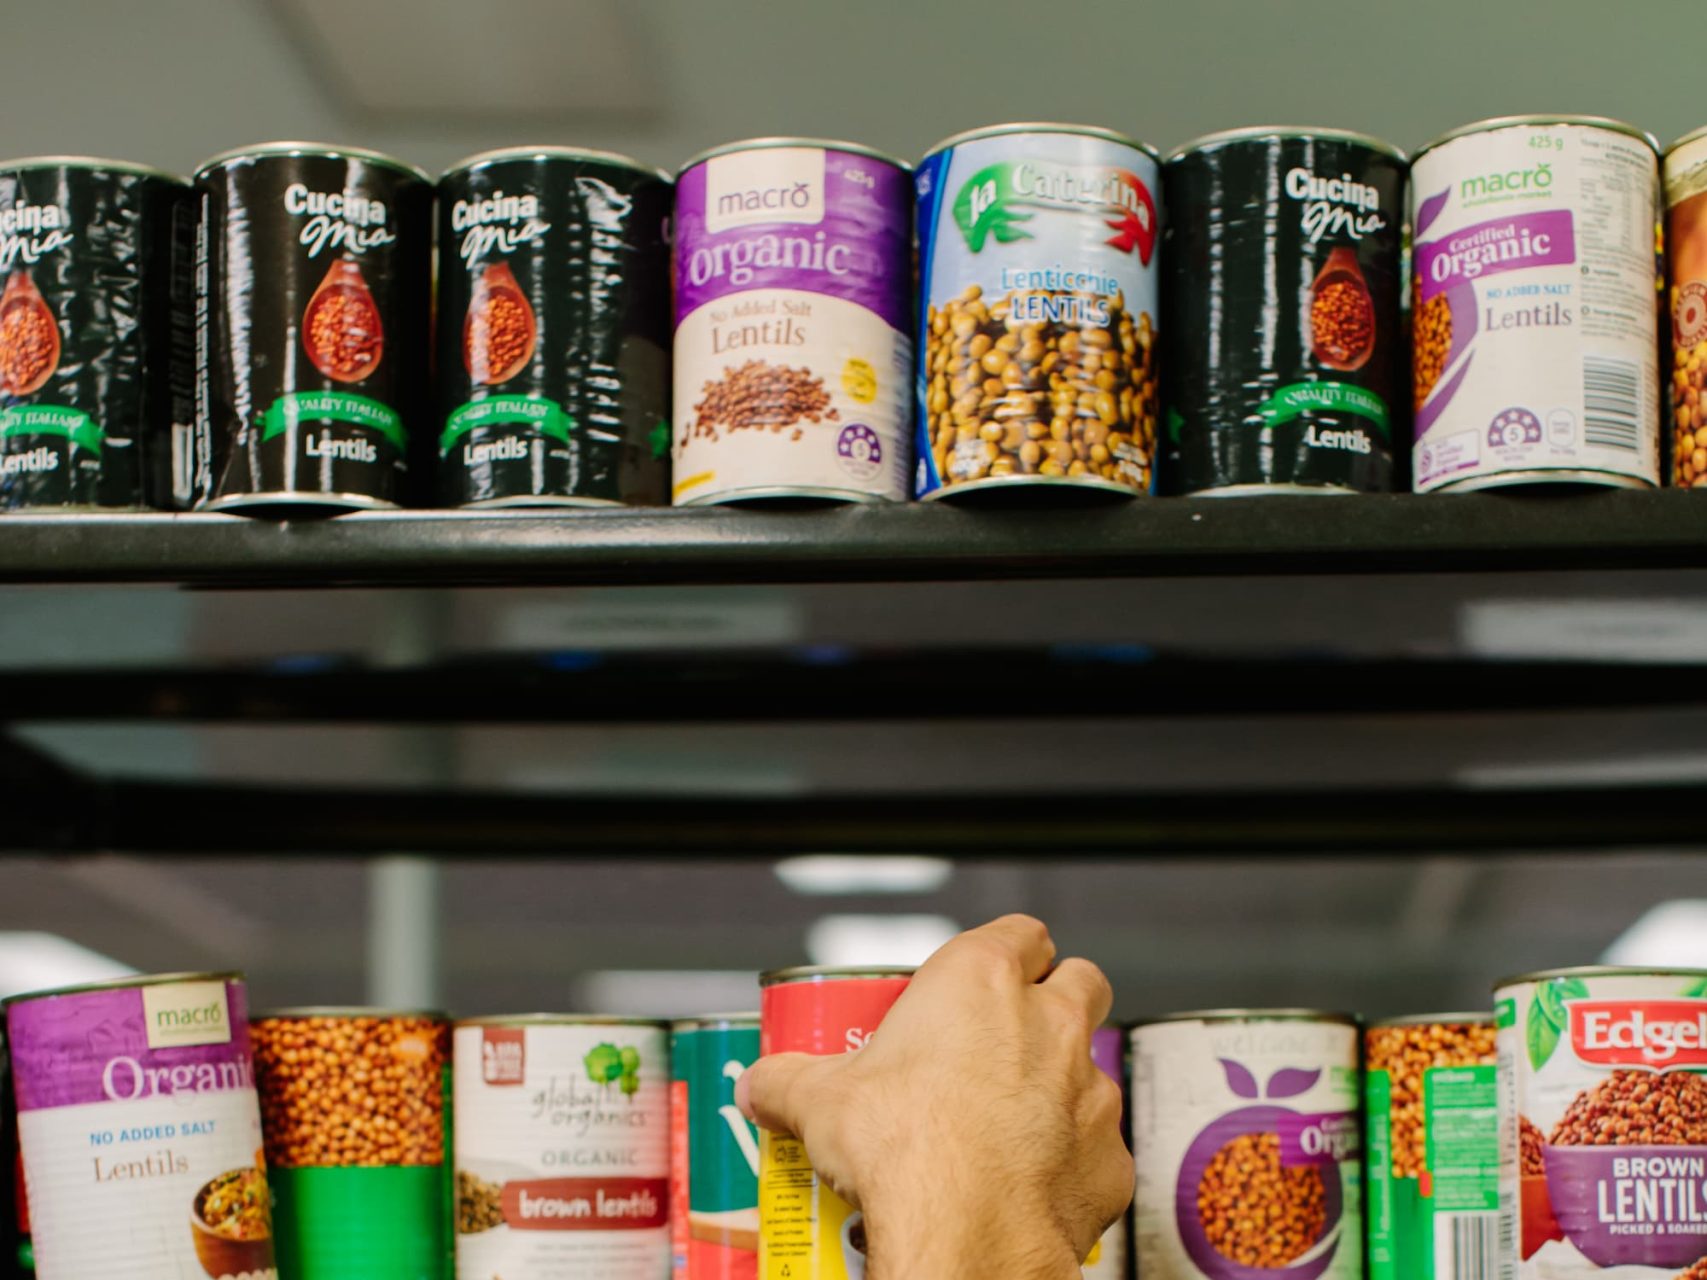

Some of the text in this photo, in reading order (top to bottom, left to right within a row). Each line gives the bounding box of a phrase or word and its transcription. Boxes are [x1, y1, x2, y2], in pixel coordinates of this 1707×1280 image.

[284, 183, 386, 226] Cucina
[1012, 163, 1151, 233] Caterina
[1285, 167, 1379, 213] Cucina
[0, 200, 61, 234] cina
[452, 191, 538, 232] Cucina
[1301, 201, 1386, 244] Mia
[300, 215, 396, 258] Mia
[460, 221, 550, 270] Mia
[1449, 224, 1516, 254] Certified
[1431, 229, 1551, 283] Organic
[1000, 264, 1120, 296] Lenticchie
[1011, 295, 1112, 327] LENTILS
[1486, 302, 1573, 332] Lentils
[711, 317, 806, 355] Lentils
[306, 433, 377, 463] Lentils
[464, 436, 528, 465] Lentils
[1306, 424, 1372, 455] Lentils
[103, 1054, 255, 1104] Organi
[91, 1120, 216, 1146] NO ADDED SALT
[94, 1149, 190, 1182] Lentils
[541, 1150, 638, 1166] ORGANIC
[1613, 1157, 1704, 1178] BROWN
[519, 1188, 657, 1219] brown lentils
[1598, 1179, 1707, 1223] LENTIL
[1610, 1223, 1654, 1235] PICKED
